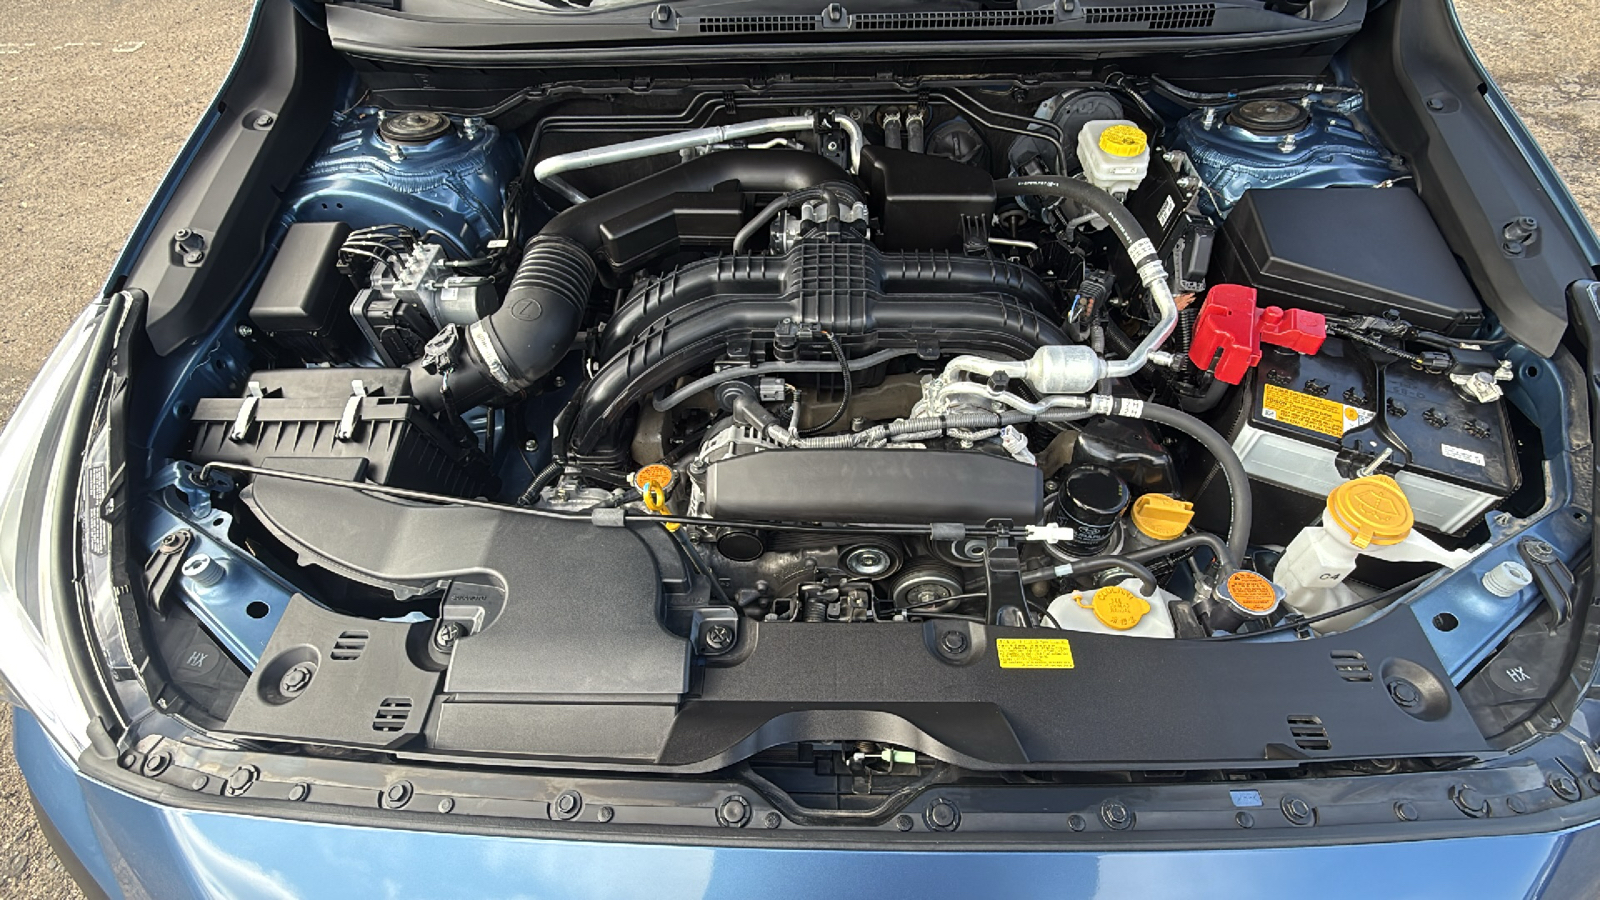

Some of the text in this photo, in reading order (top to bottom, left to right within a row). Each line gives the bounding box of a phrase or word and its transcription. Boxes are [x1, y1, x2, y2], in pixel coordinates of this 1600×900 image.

[1319, 572, 1341, 581] C4
[187, 651, 208, 667] HX
[1506, 666, 1530, 682] HX
